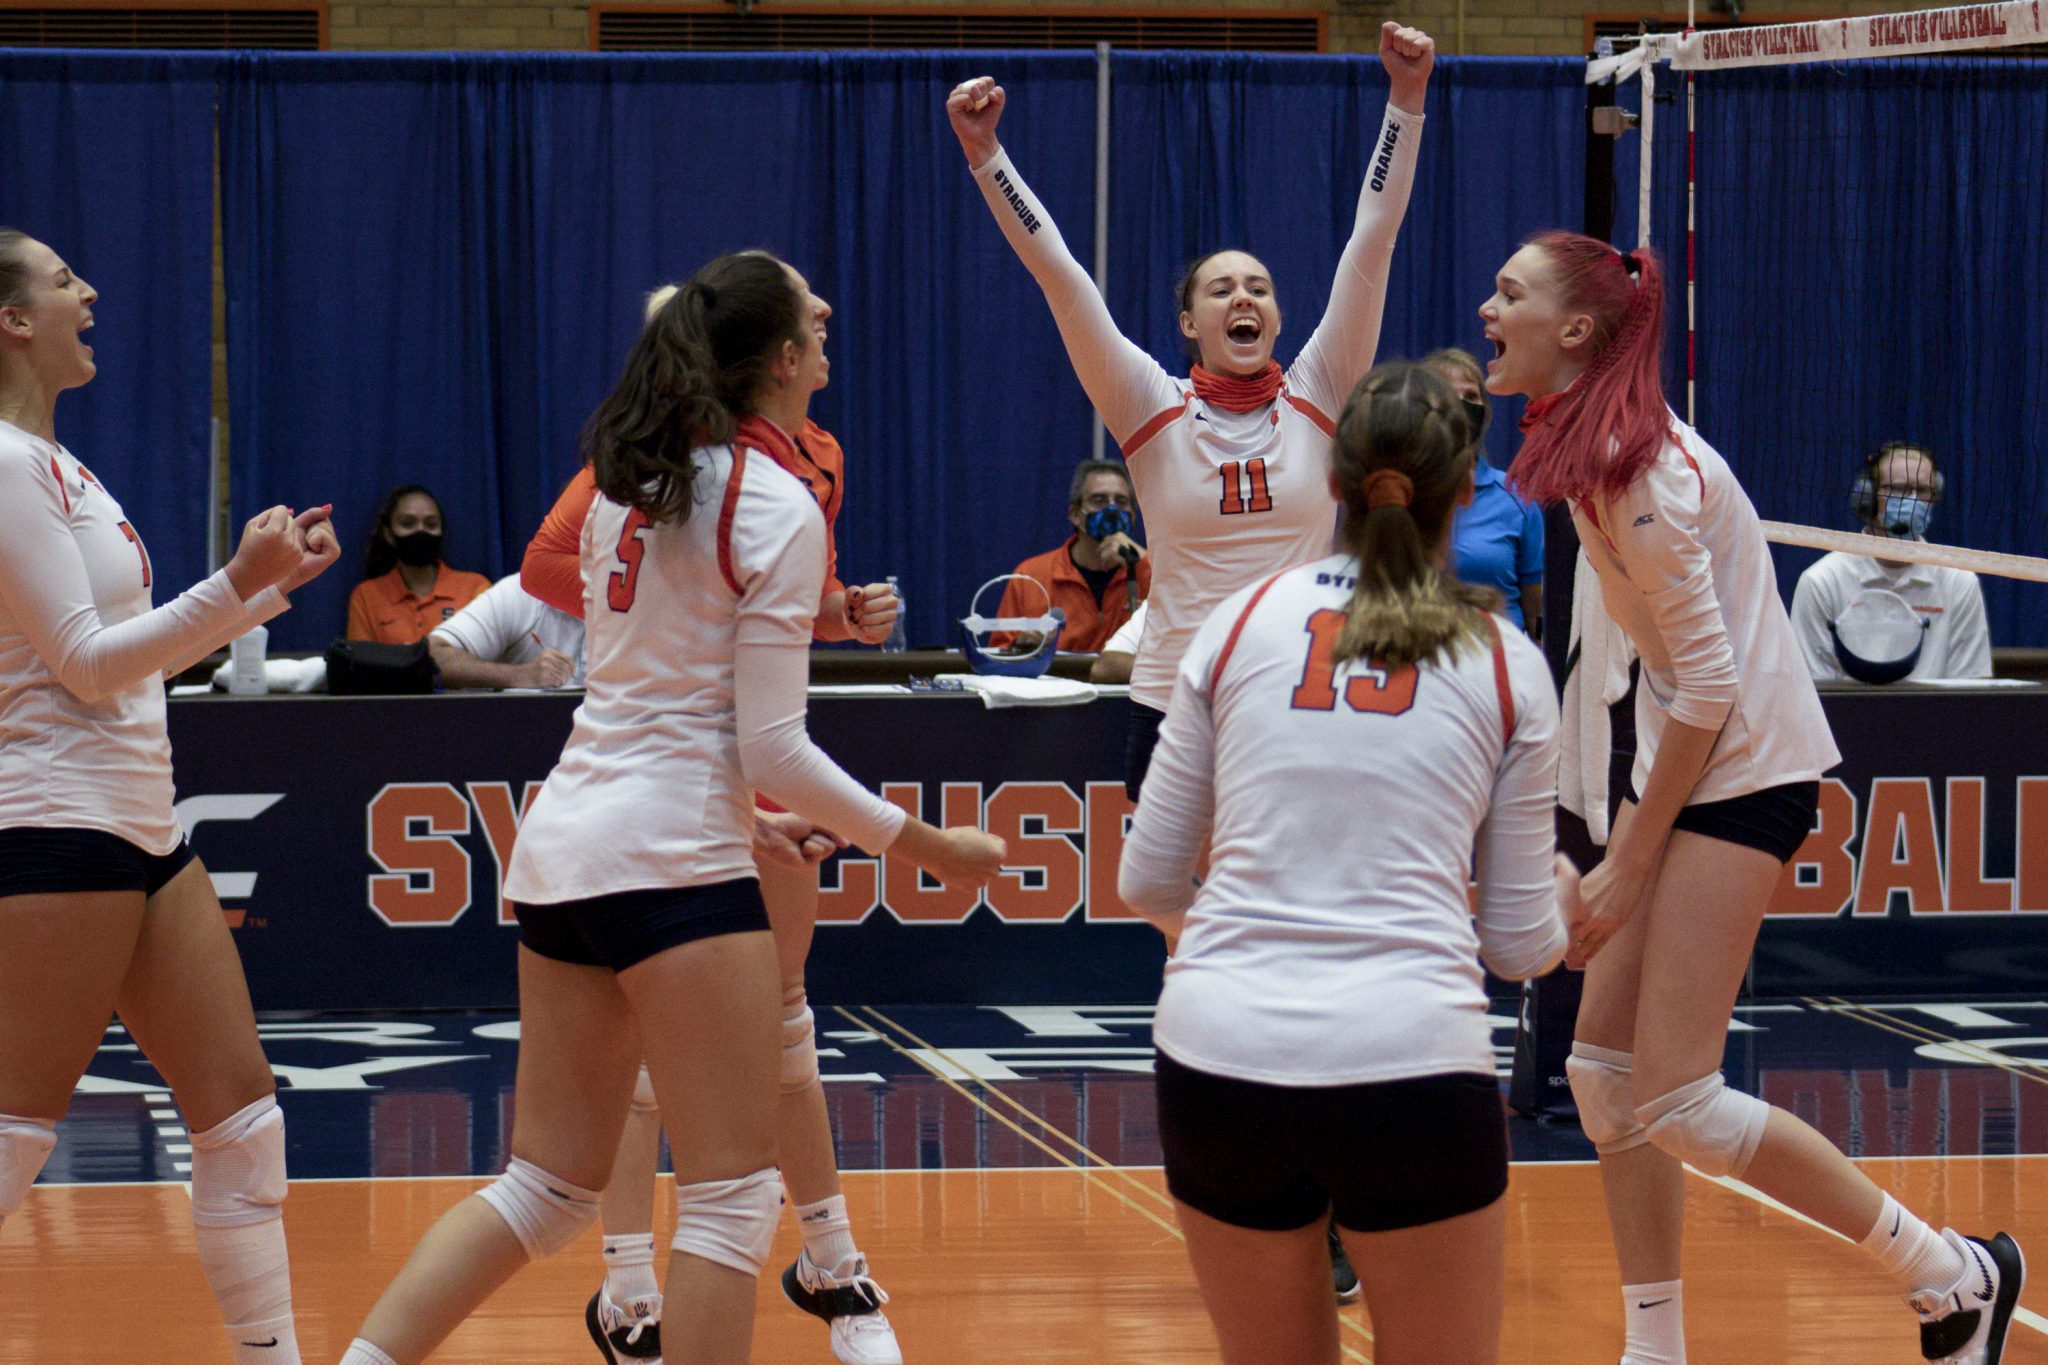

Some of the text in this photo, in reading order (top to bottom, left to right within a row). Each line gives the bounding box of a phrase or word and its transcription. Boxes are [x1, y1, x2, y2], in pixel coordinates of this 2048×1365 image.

[1370, 120, 1400, 192] ORANGE
[994, 169, 1041, 235] SYRACUSE
[1219, 458, 1272, 515] 11
[607, 504, 655, 613] 5
